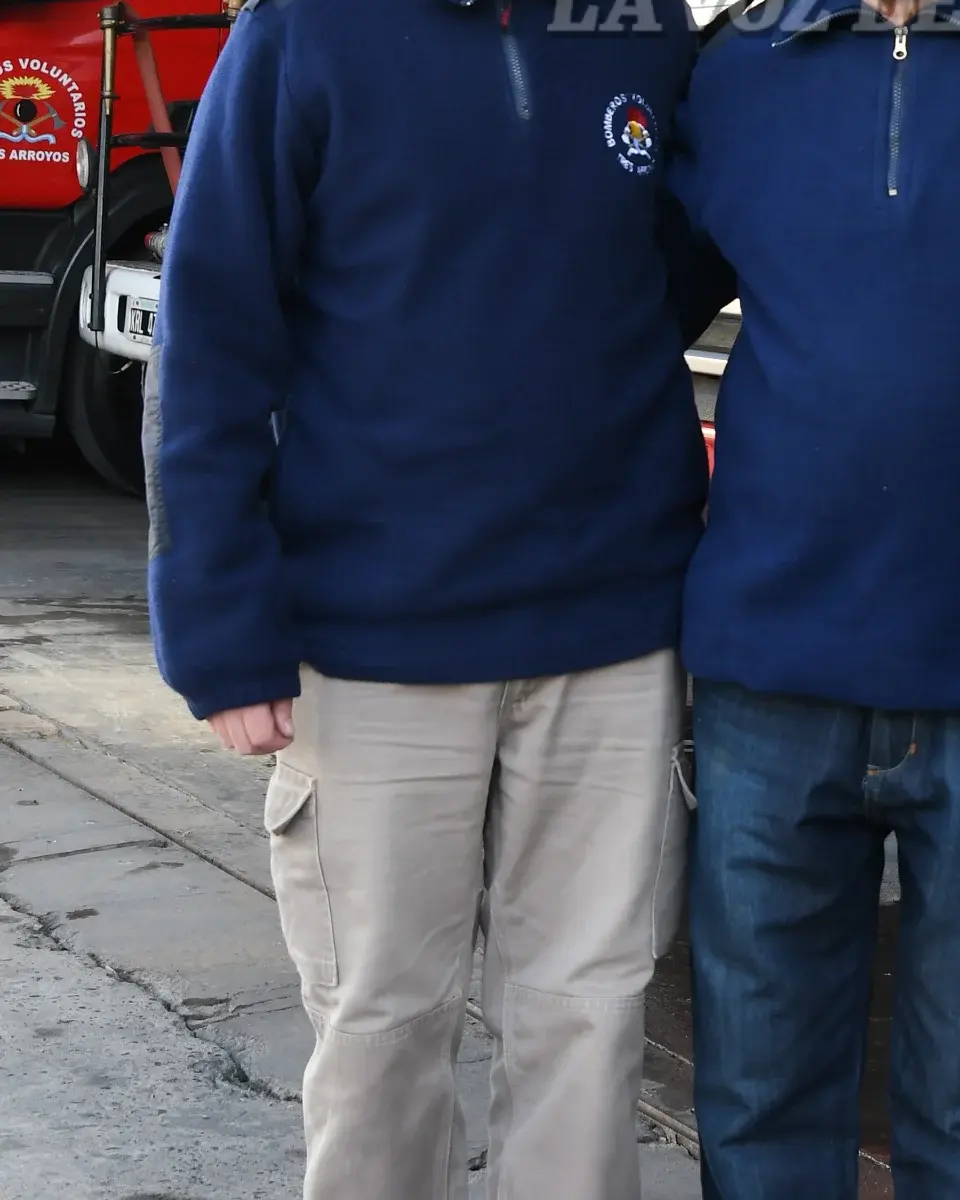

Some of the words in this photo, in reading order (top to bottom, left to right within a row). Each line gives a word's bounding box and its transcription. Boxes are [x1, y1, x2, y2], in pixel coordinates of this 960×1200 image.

[18, 58, 87, 138] VOLUNTARIOS
[603, 94, 627, 147] BOMBEROS
[9, 150, 70, 163] ARROYOS
